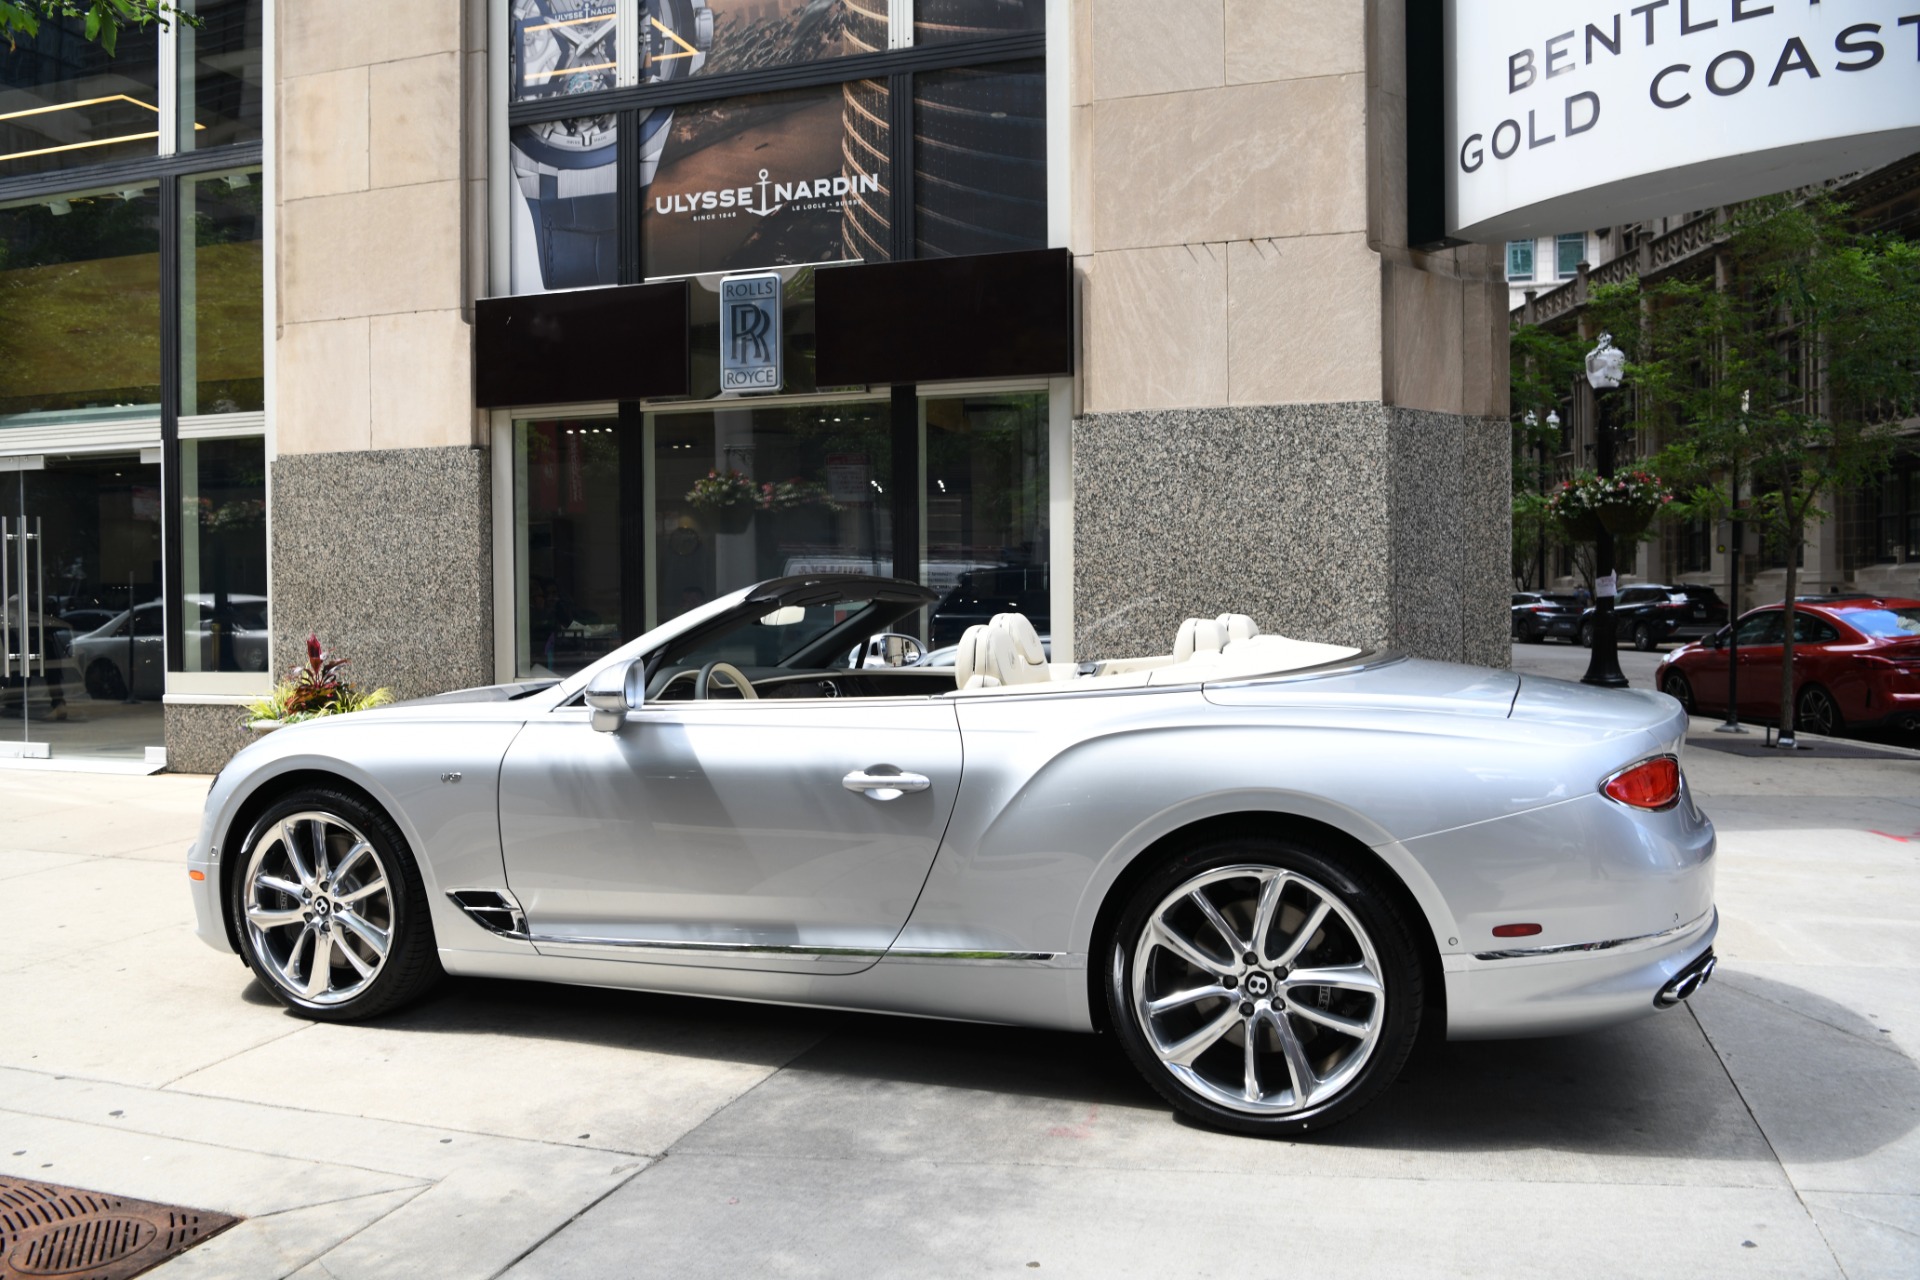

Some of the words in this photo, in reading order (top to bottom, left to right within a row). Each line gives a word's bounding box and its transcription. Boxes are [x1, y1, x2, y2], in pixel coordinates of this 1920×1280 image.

[590, 6, 616, 16] NARDI
[1509, 0, 1821, 95] BENTL
[1460, 90, 1601, 173] GOLD
[655, 187, 753, 214] ULYSSE
[774, 173, 879, 203] NARDIN
[803, 202, 826, 210] LOCLE
[692, 213, 716, 222] SINCE
[718, 211, 737, 219] 1846
[726, 281, 773, 298] ROLLS
[726, 369, 774, 385] ROYCE
